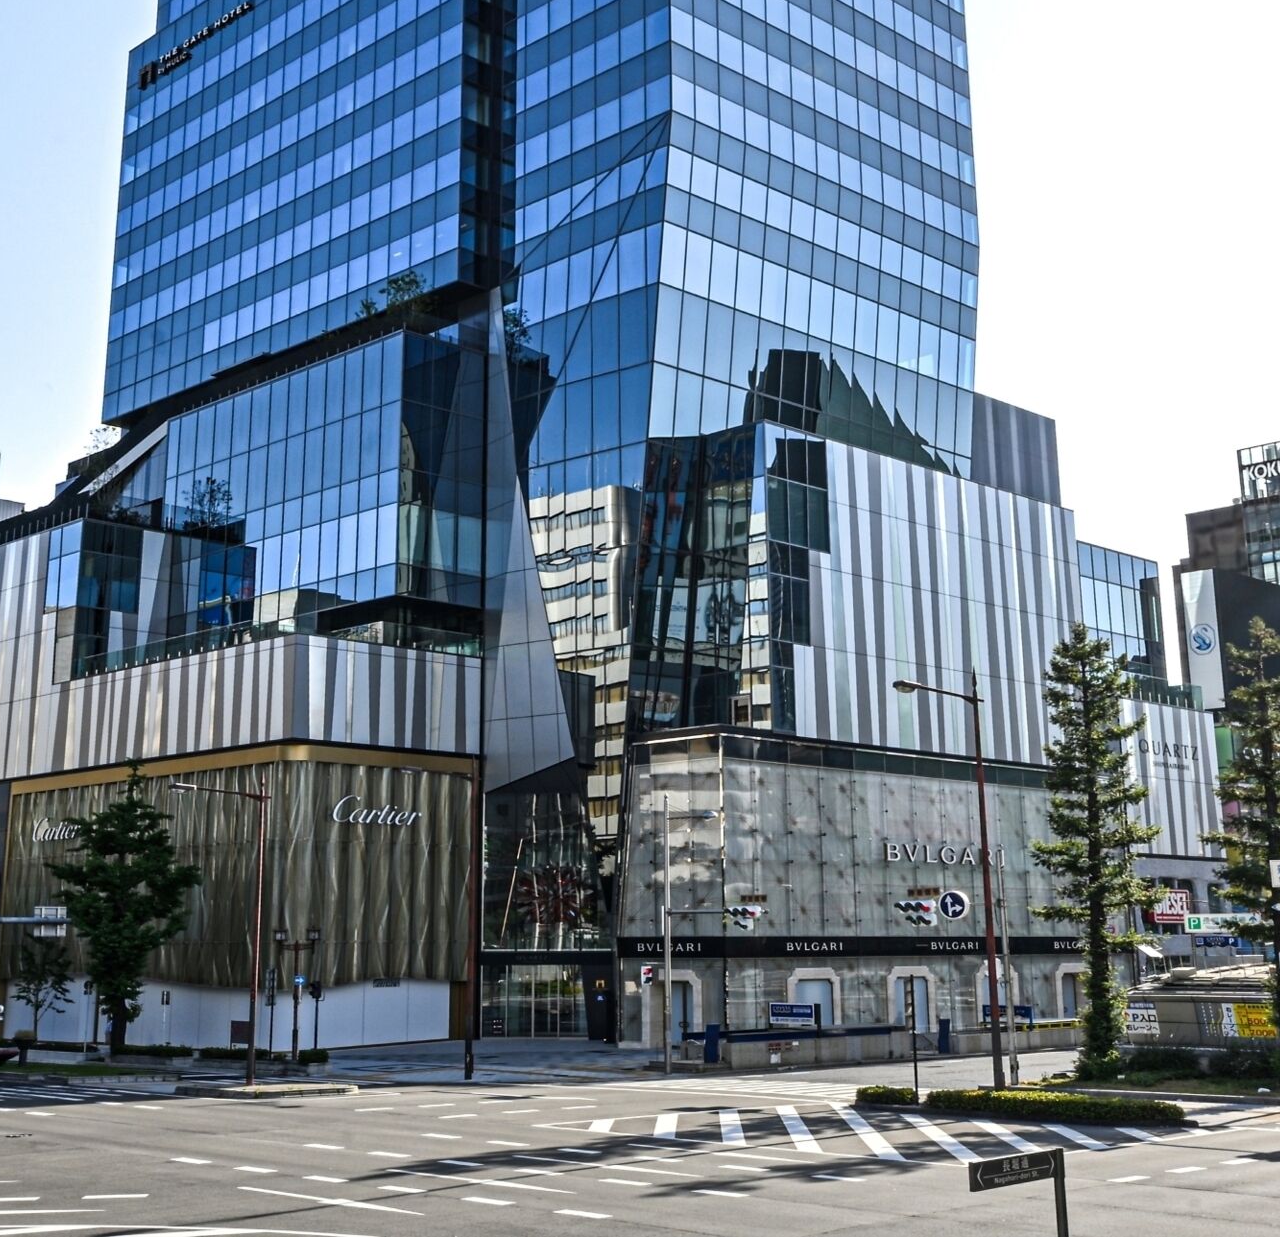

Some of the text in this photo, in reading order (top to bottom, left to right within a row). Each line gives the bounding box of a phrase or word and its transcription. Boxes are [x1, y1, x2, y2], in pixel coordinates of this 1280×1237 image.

[159, 1, 250, 63] THE GATE HOTEL
[1138, 738, 1199, 761] QUARTZ
[333, 794, 422, 826] Cartier
[32, 817, 81, 843] Cartier
[885, 842, 1005, 866] BVLGARI
[1191, 918, 1199, 929] P
[786, 942, 844, 951] BVLGARI
[930, 941, 979, 950] BVLGARI
[1228, 937, 1235, 945] P
[636, 942, 702, 952] BVLGARI
[1132, 1013, 1157, 1022] P入口
